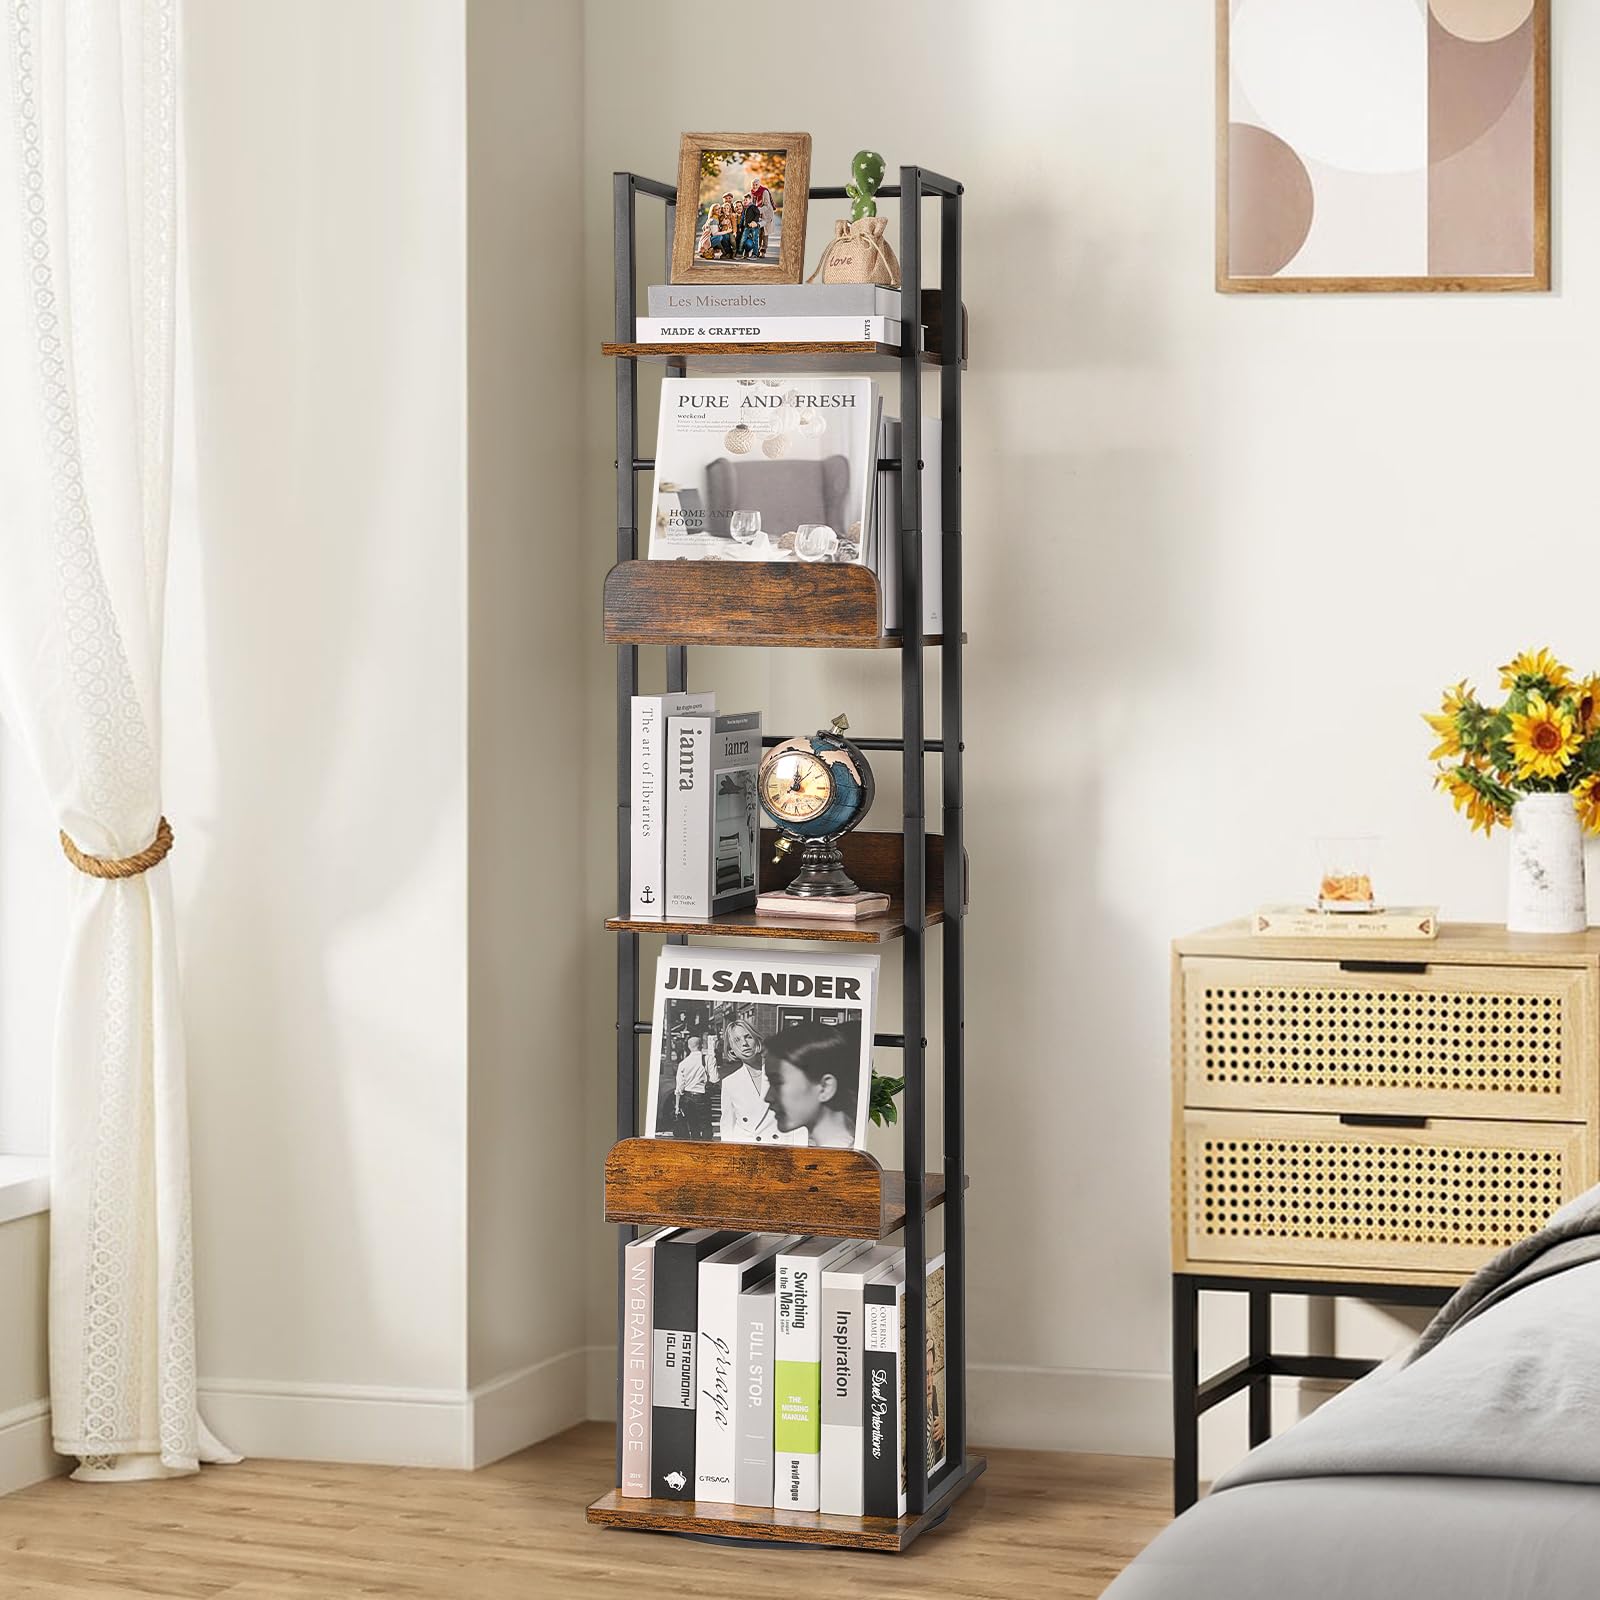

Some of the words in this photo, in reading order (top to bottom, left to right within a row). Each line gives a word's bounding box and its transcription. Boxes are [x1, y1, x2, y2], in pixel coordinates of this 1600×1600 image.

[830, 256, 852, 267] love
[669, 296, 692, 306] Les
[696, 294, 766, 306] Miserables
[660, 328, 695, 336] MADE
[698, 328, 706, 336] &
[708, 327, 761, 336] CRAFTED
[678, 395, 729, 408] PURE
[740, 395, 783, 408] AND
[794, 394, 856, 408] FRESH
[642, 708, 654, 733] The
[642, 738, 651, 756] art
[725, 737, 749, 756] ianra
[642, 762, 654, 777] of
[679, 728, 702, 791] ianra
[642, 781, 654, 837] libraries
[665, 967, 708, 991] JIL
[711, 970, 861, 1000] SANDER
[780, 1277, 788, 1289] the
[780, 1292, 793, 1317] Mac
[792, 1272, 808, 1328] Switching
[630, 1260, 646, 1370] WYBRANE
[666, 1332, 676, 1368] IGLOO
[750, 1321, 763, 1360] FULL
[833, 1311, 851, 1397] Inspiration
[748, 1364, 762, 1408] STOP.
[872, 1369, 887, 1402] Duel
[629, 1379, 644, 1451] PRACE
[782, 1404, 808, 1412] MISSING
[782, 1413, 808, 1422] MANUAL
[871, 1402, 887, 1460] Intentions
[791, 1460, 800, 1479] David
[790, 1480, 800, 1501] Pogue
